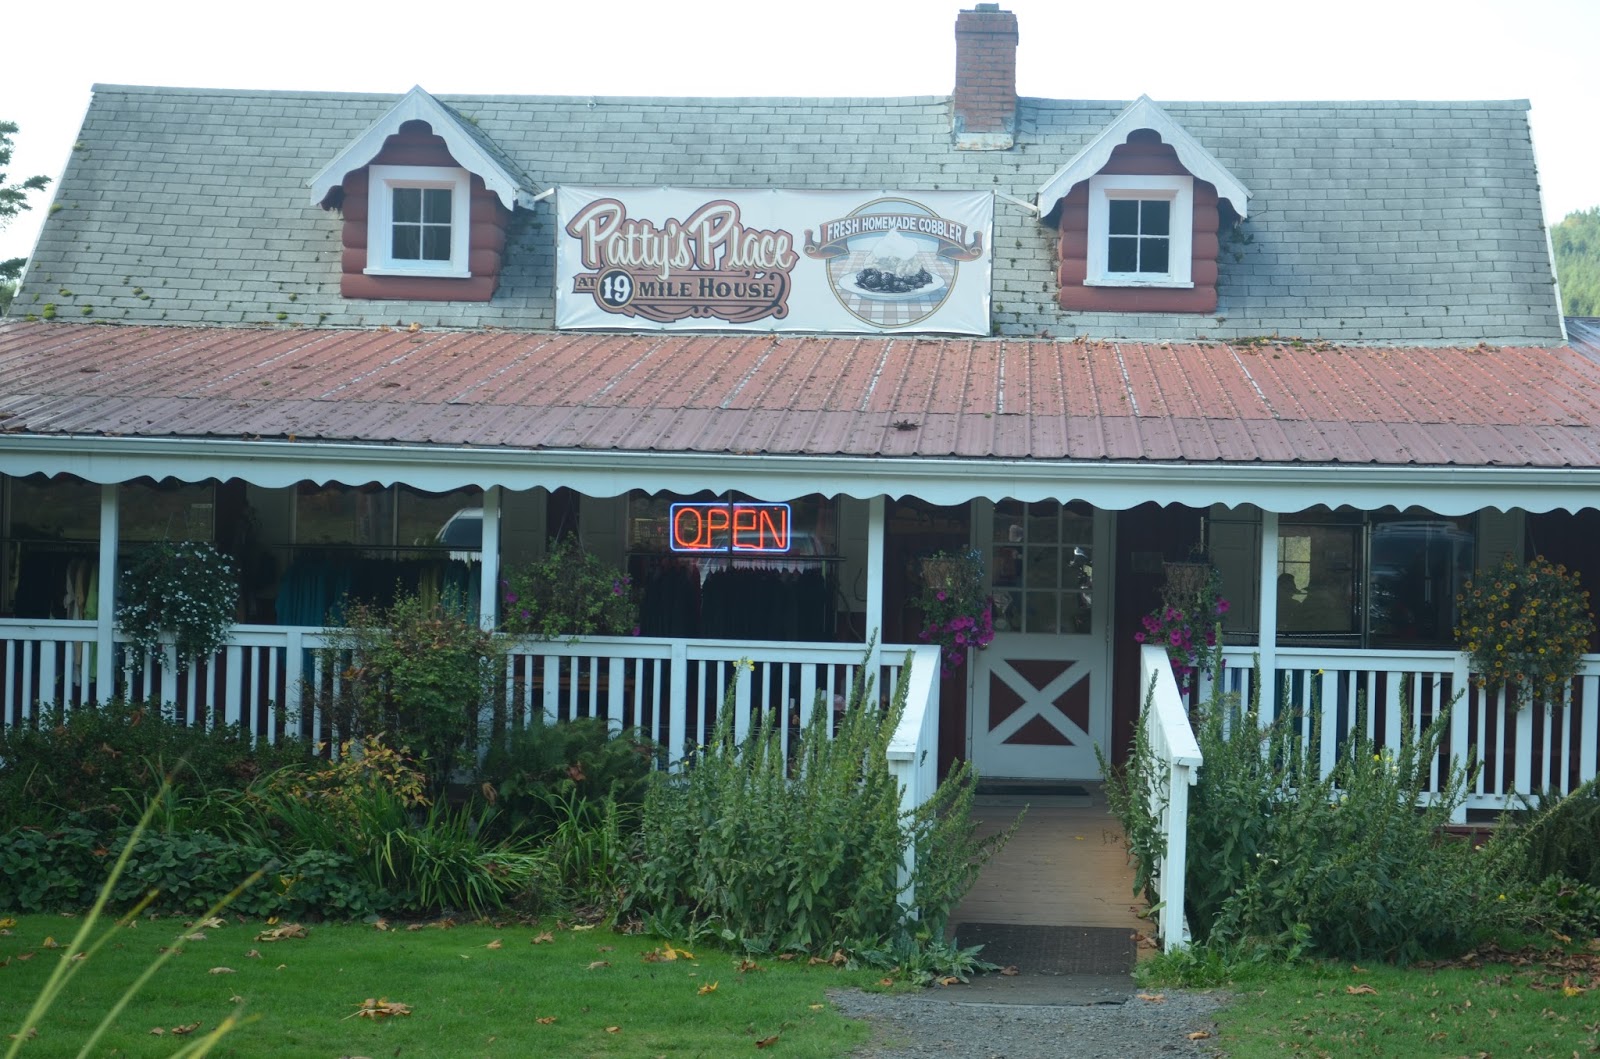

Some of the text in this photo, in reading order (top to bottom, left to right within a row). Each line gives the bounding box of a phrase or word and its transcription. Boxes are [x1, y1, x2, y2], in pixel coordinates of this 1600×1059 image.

[570, 200, 797, 281] Patty's Place
[827, 216, 963, 243] FRESH HOMEMADE COBBLER
[577, 275, 776, 302] AT 19 MILE HOUSE
[674, 507, 786, 549] OPEN
